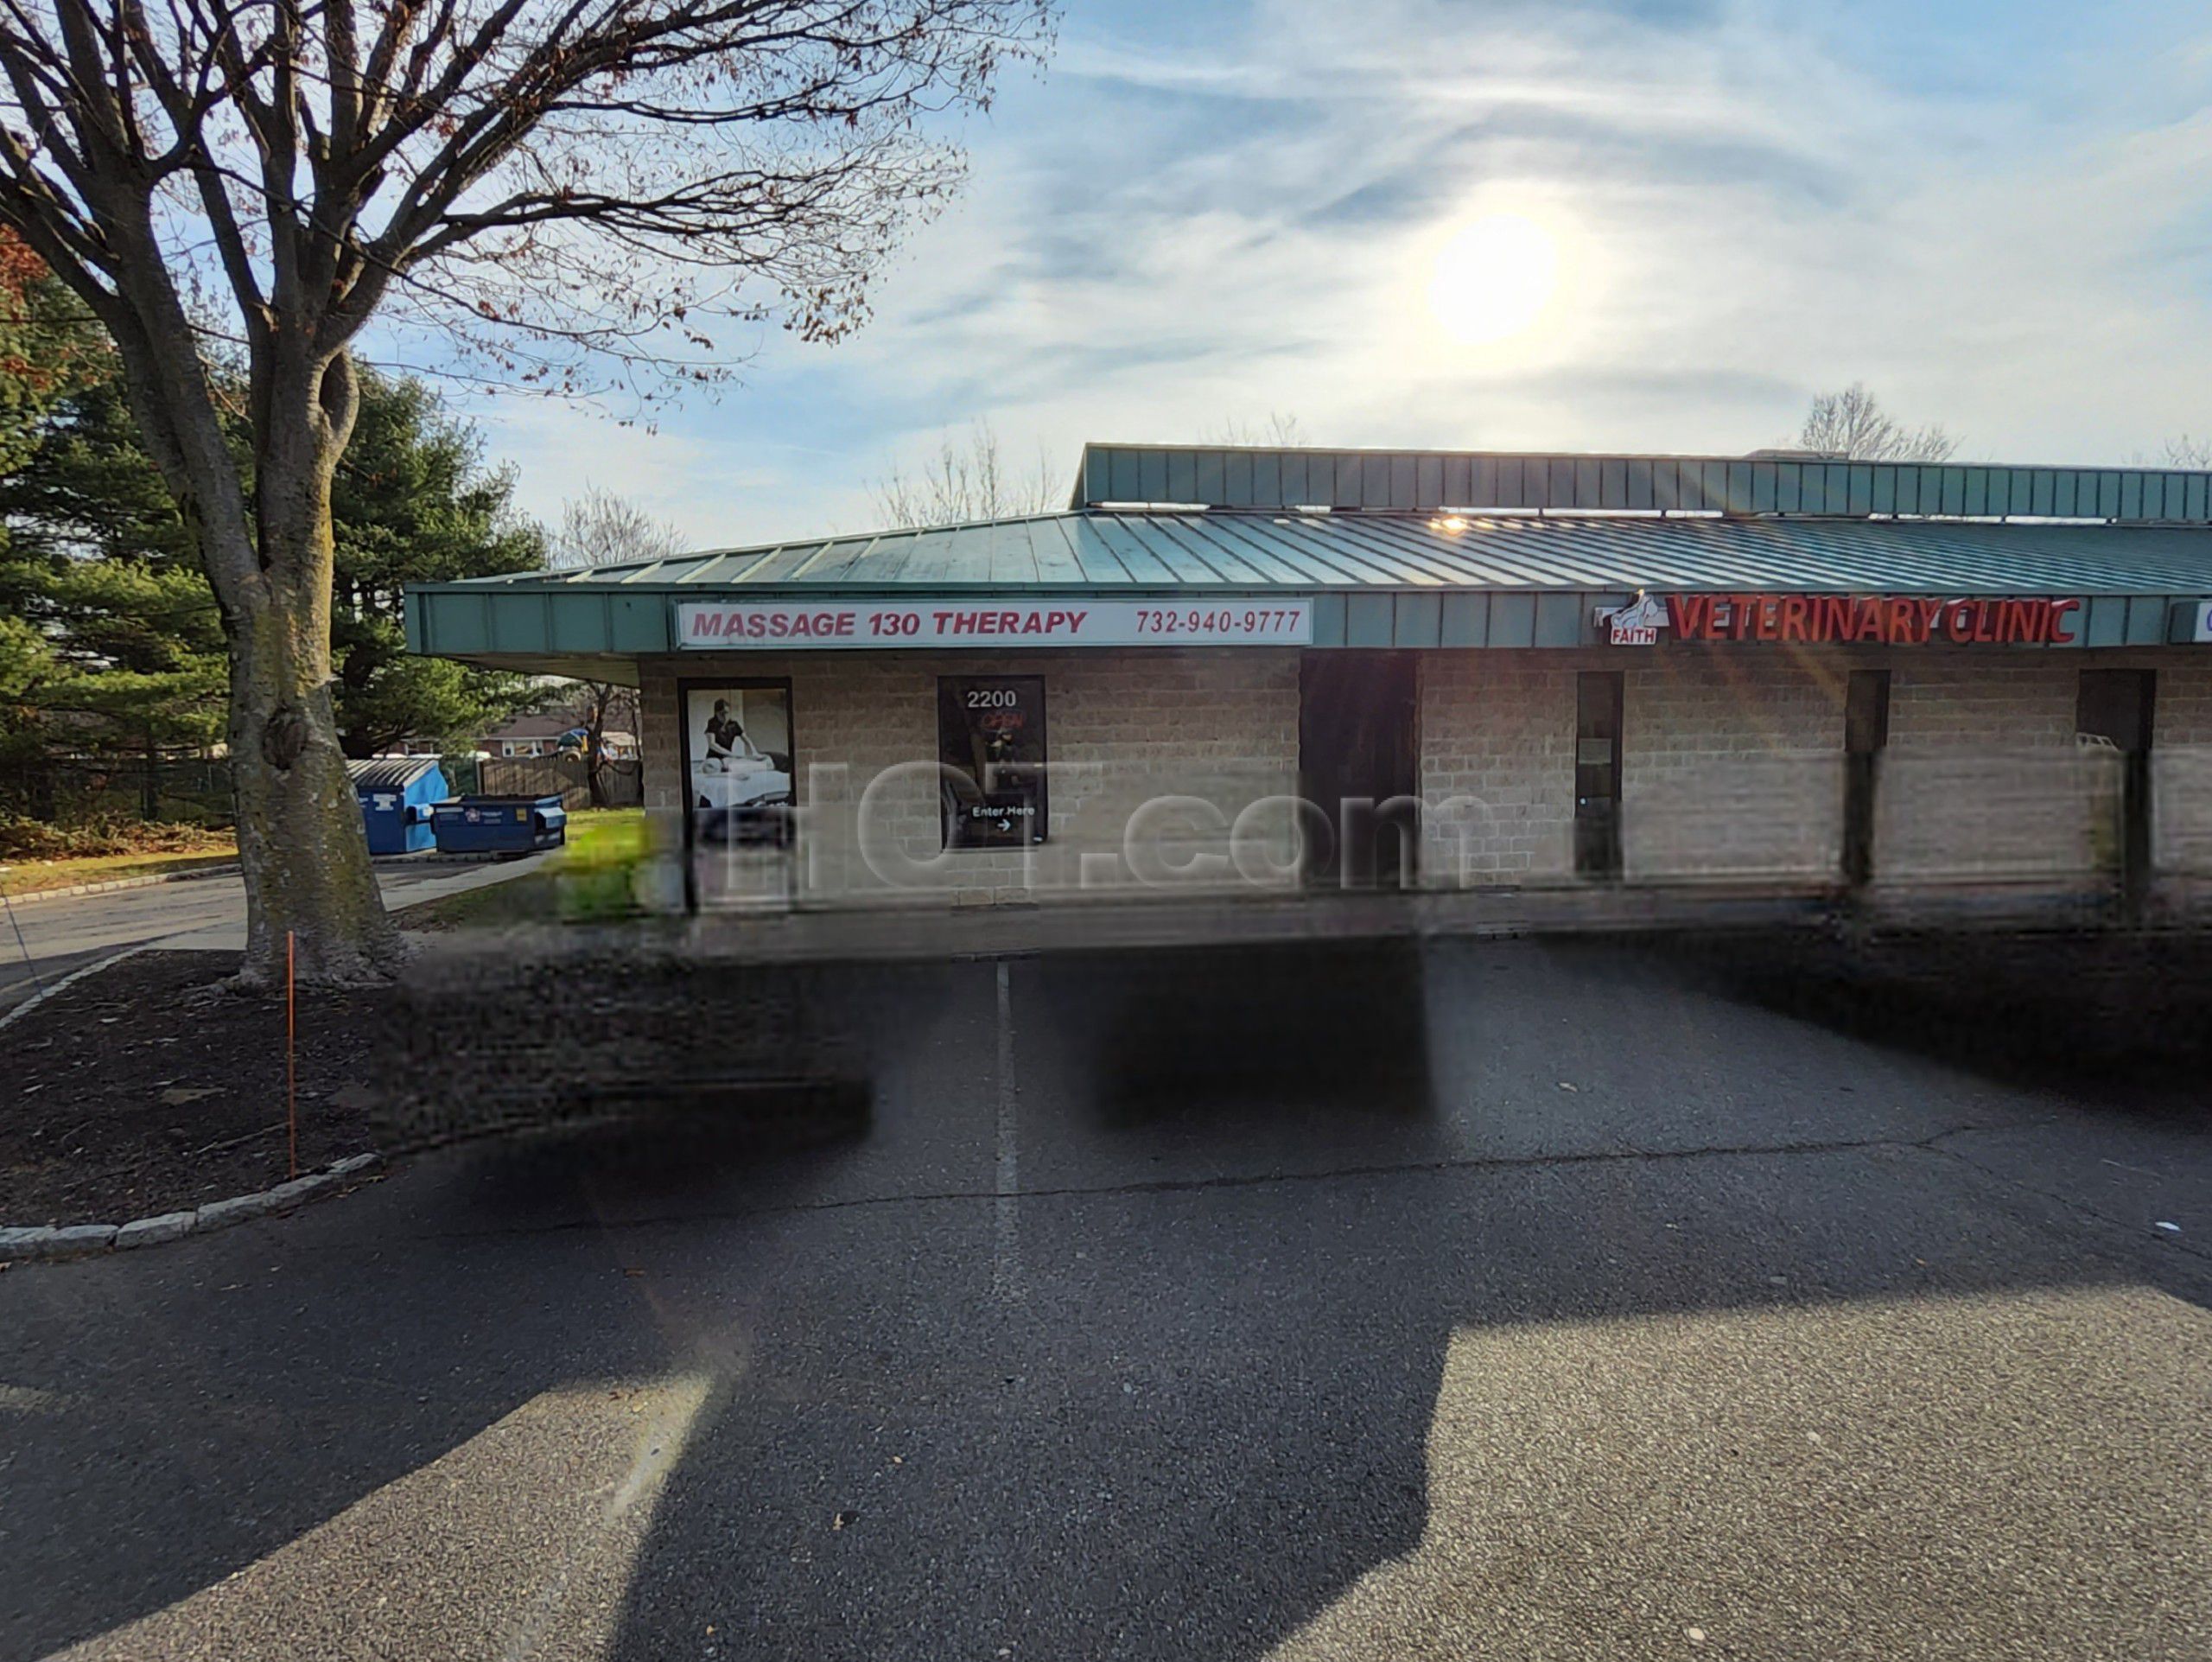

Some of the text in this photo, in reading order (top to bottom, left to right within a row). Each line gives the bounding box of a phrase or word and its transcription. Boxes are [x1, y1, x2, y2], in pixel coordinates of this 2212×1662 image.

[691, 610, 1088, 638] MASSAGE 130 THERAPY
[1136, 610, 1300, 633] 732-940-9777
[1667, 592, 2081, 644] VETERINARY CLINIC
[1612, 628, 1655, 643] FAITH
[967, 690, 1017, 708] 2200
[972, 805, 1036, 818] Enter Here
